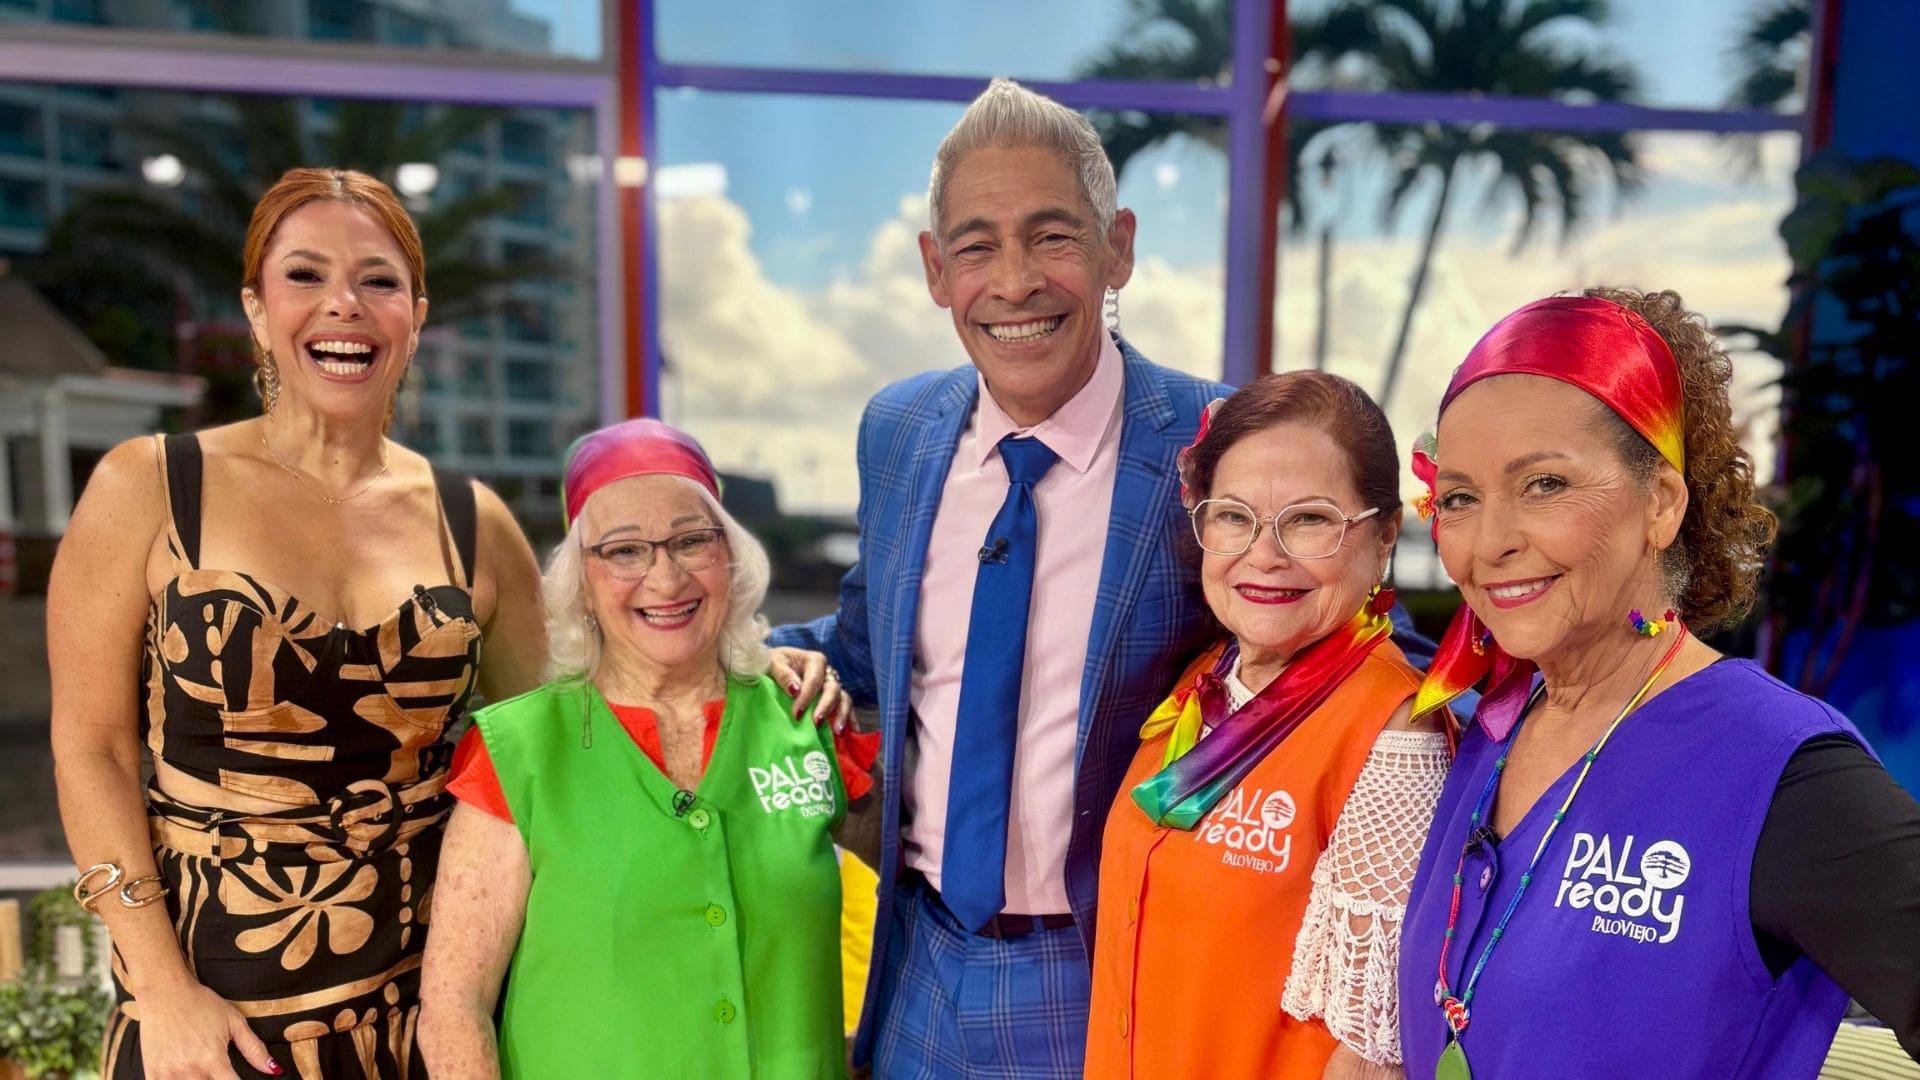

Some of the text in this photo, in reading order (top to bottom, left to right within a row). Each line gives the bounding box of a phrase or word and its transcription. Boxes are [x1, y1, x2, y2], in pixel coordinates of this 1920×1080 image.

[761, 780, 835, 815] ready
[1195, 822, 1291, 873] ready
[1563, 833, 1691, 889] PALO
[1554, 879, 1684, 944] ready
